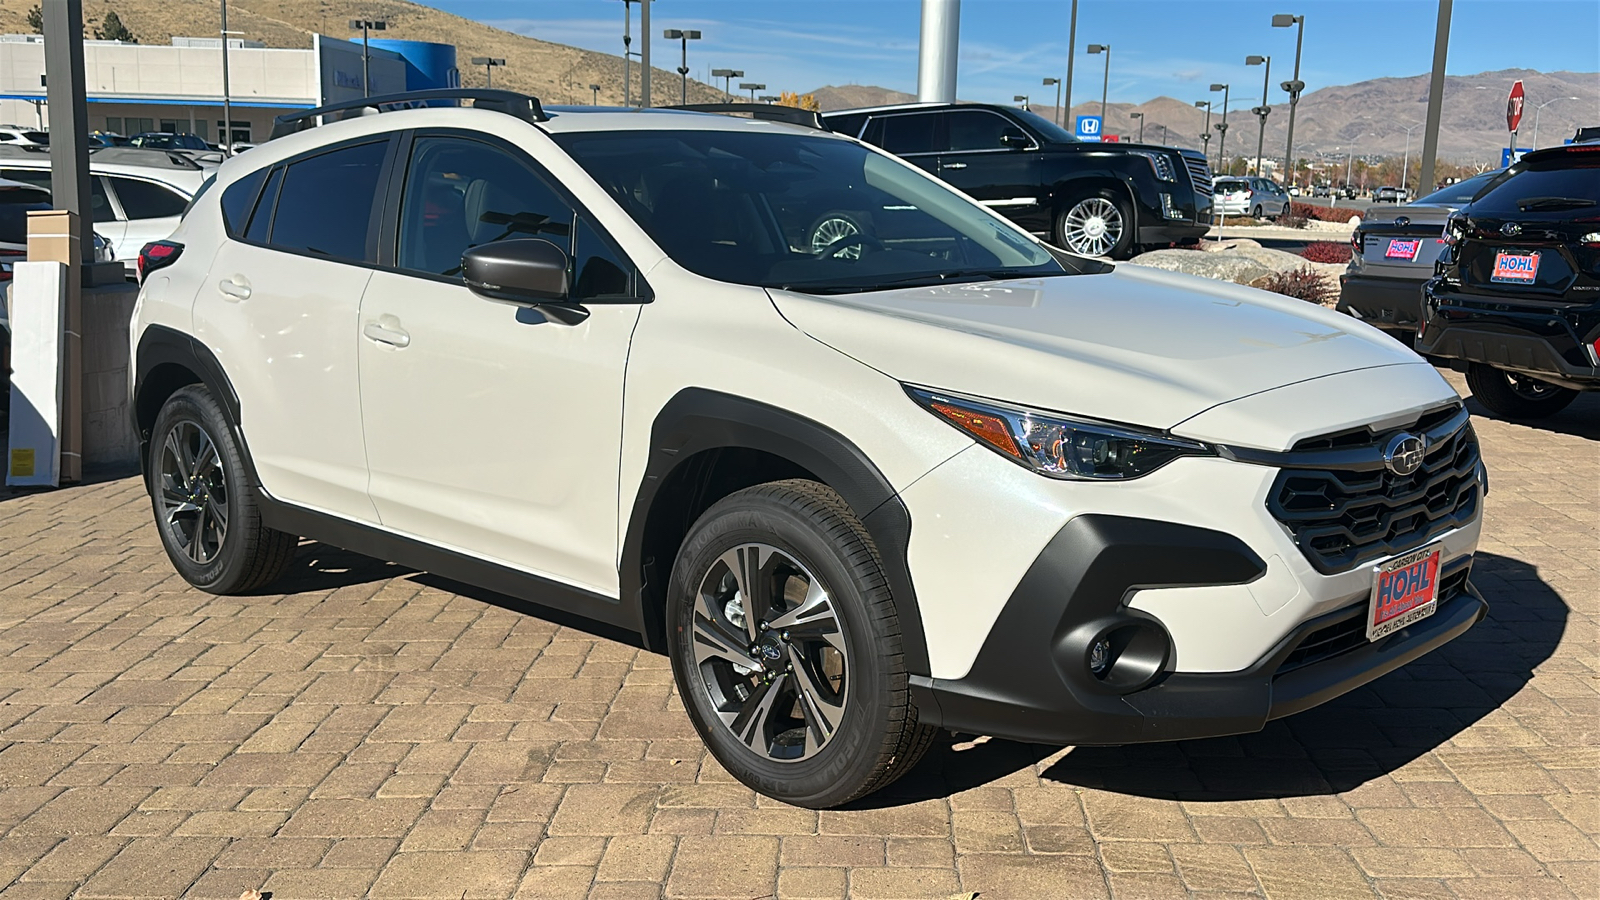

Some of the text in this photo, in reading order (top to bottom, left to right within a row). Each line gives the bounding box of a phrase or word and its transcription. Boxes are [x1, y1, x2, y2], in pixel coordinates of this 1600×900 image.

[1508, 97, 1523, 116] STOP
[1391, 243, 1415, 253] HOHL
[1499, 257, 1534, 272] HOHL
[1392, 554, 1415, 571] CARSON
[1377, 561, 1430, 608] HOHL
